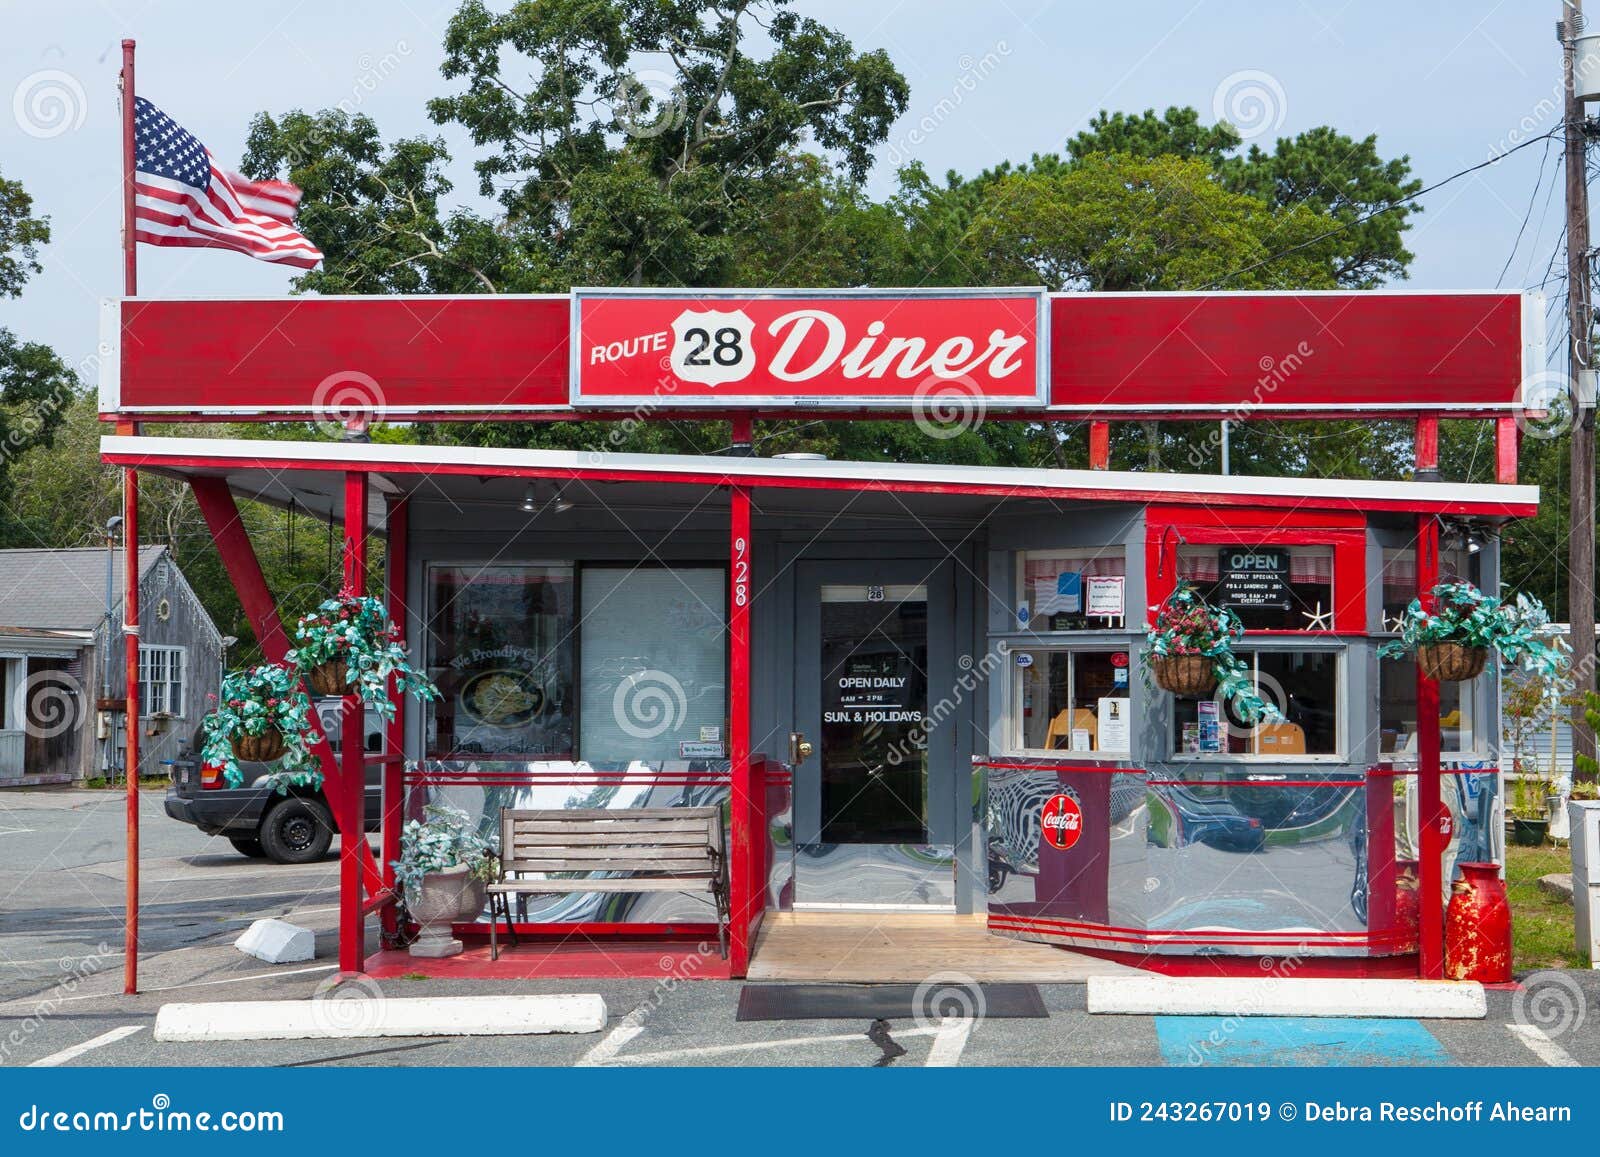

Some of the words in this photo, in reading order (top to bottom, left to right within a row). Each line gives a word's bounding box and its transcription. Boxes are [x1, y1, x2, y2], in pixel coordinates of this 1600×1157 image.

[591, 331, 668, 365] ROUTE
[683, 327, 743, 366] 28
[767, 309, 1028, 382] Diner
[1231, 554, 1278, 569] OPEN
[735, 537, 748, 606] 928
[870, 591, 882, 599] 28
[839, 677, 871, 688] OPEN
[873, 677, 906, 688] DAILY
[824, 711, 851, 722] SUN.
[853, 711, 863, 722] &
[866, 711, 922, 722] HOLIDAYS
